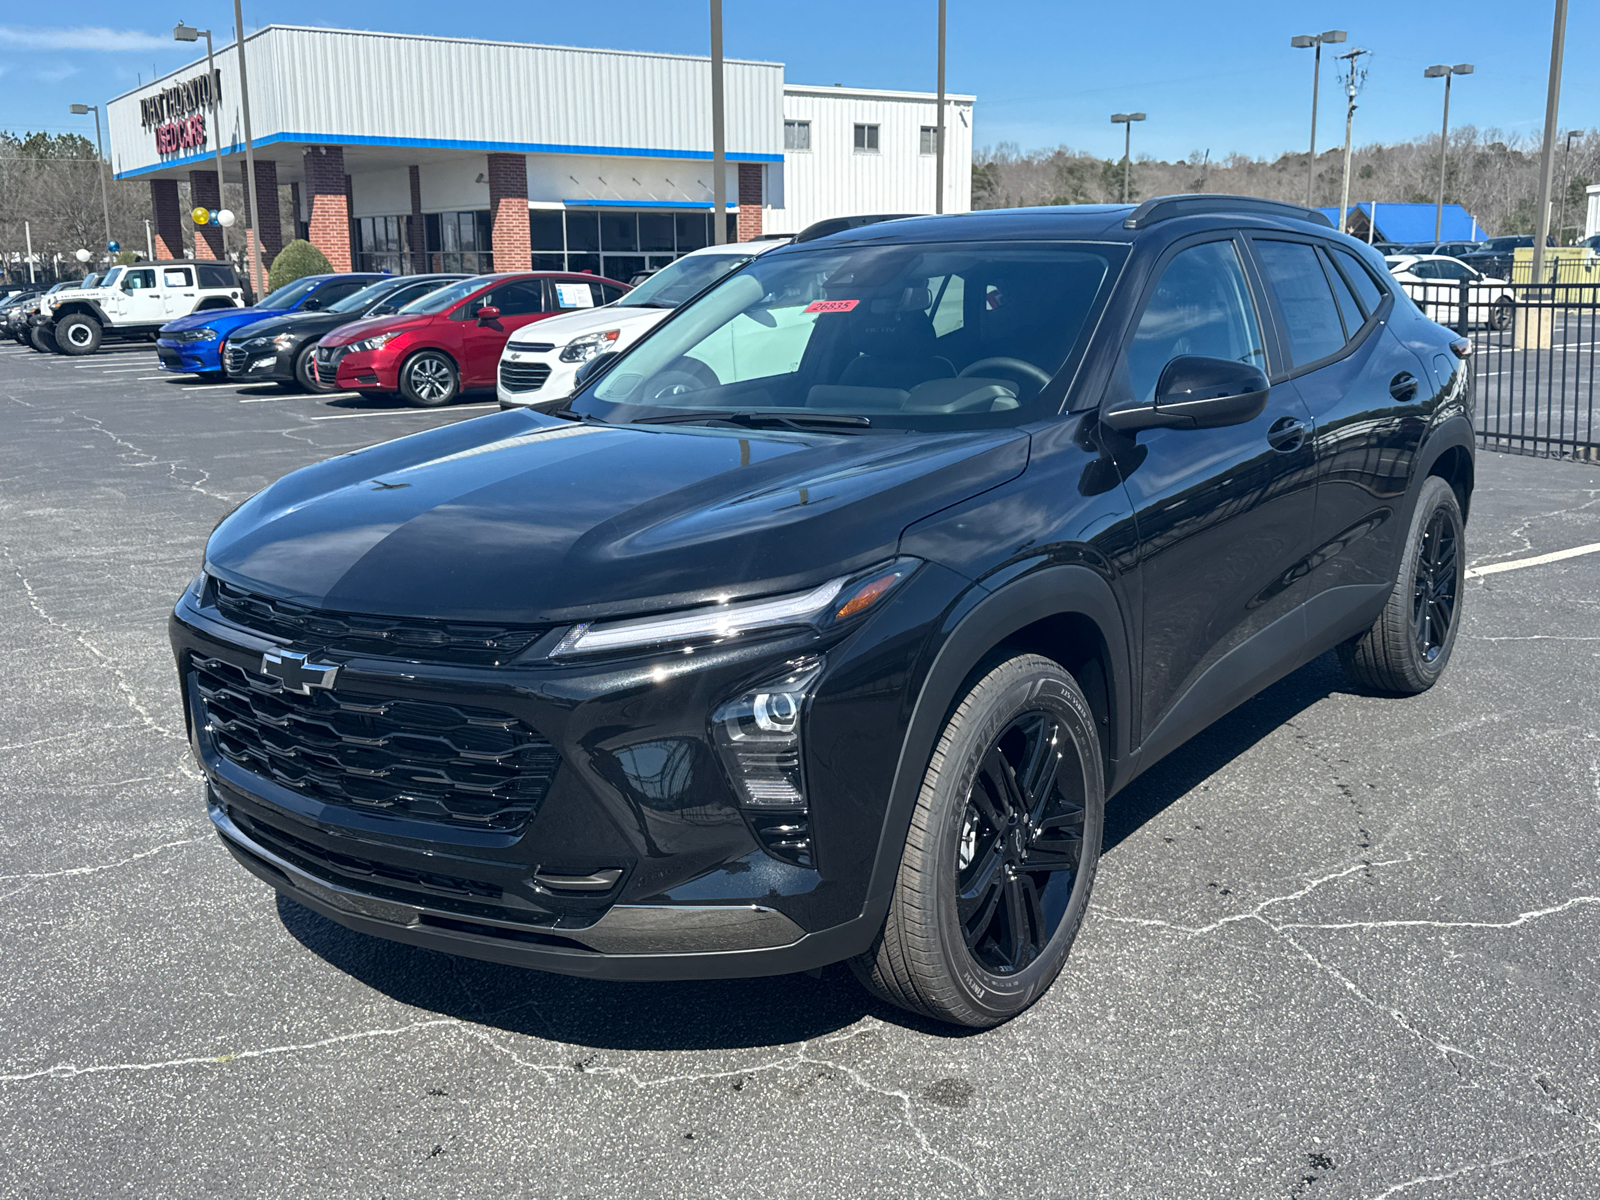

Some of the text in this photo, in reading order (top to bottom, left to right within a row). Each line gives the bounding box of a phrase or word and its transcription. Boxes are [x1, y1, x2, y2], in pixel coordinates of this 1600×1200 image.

[139, 94, 165, 127] JOHN
[154, 114, 205, 154] USED CARS
[812, 302, 851, 311] 26835
[963, 971, 986, 999] FINESSE
